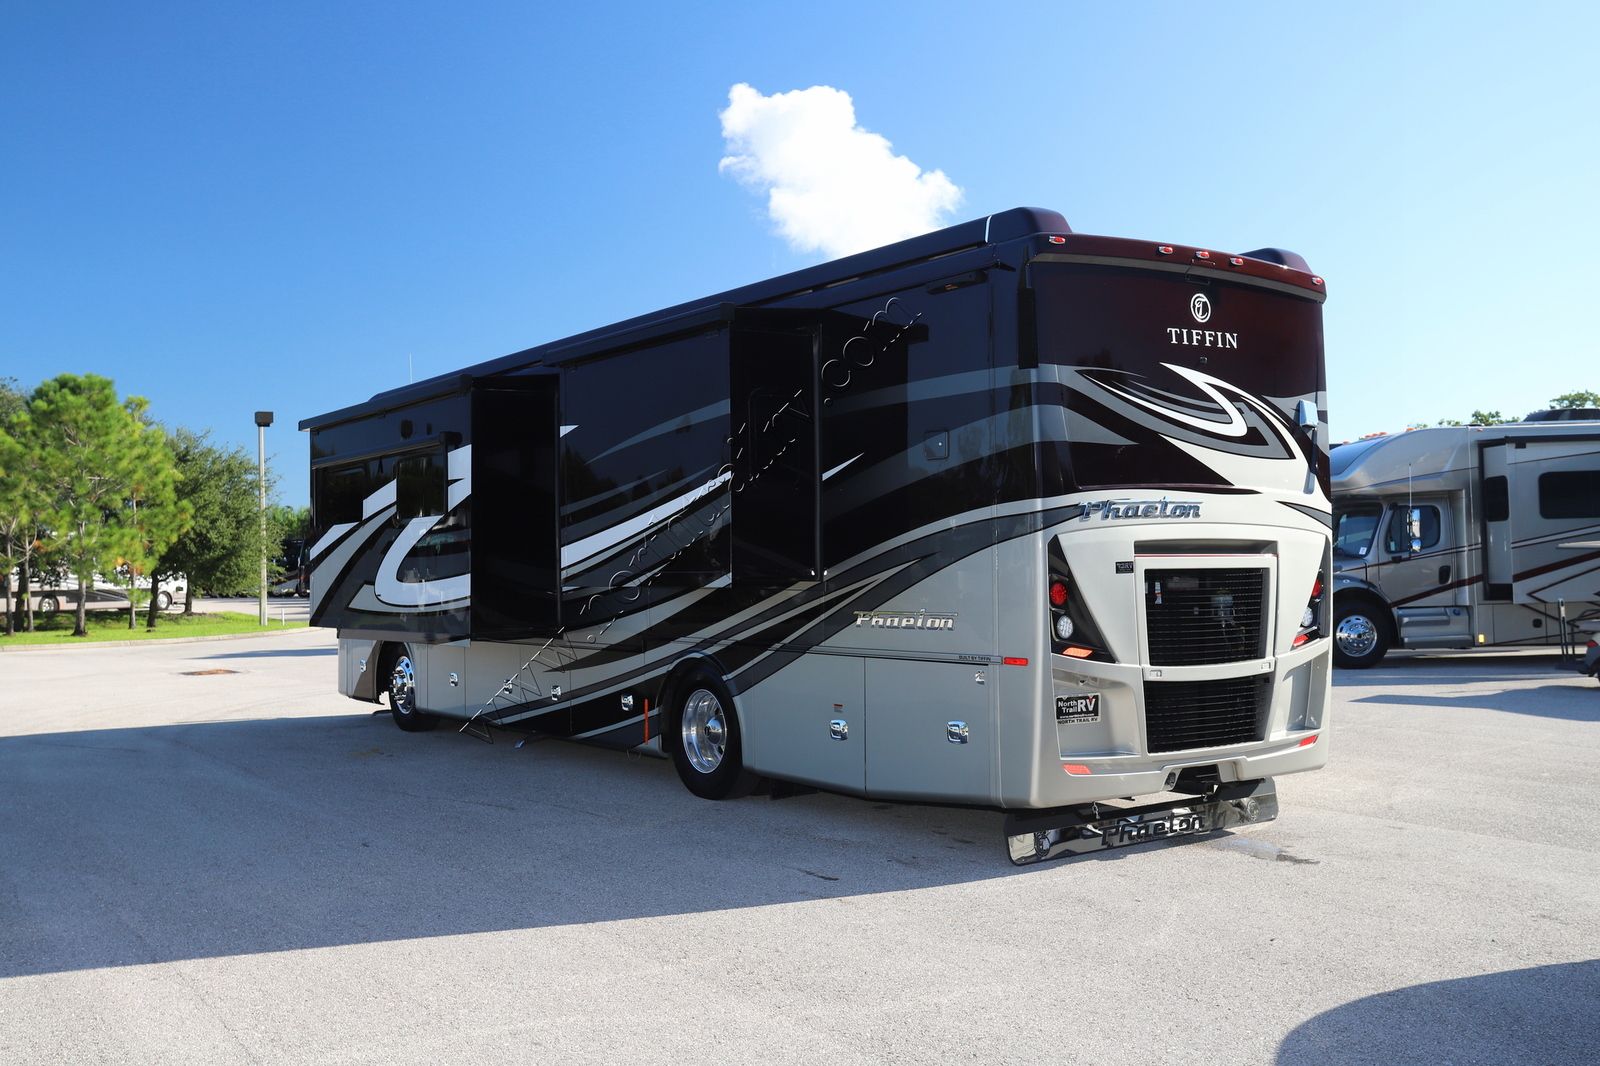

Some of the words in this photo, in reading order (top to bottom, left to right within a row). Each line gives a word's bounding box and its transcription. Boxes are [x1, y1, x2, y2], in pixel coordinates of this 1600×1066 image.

[1166, 327, 1238, 349] TIFFIN
[1078, 496, 1203, 523] Phaeton
[853, 608, 958, 631] Phaeton
[1078, 698, 1096, 712] RV
[1101, 812, 1205, 846] Phaeton
